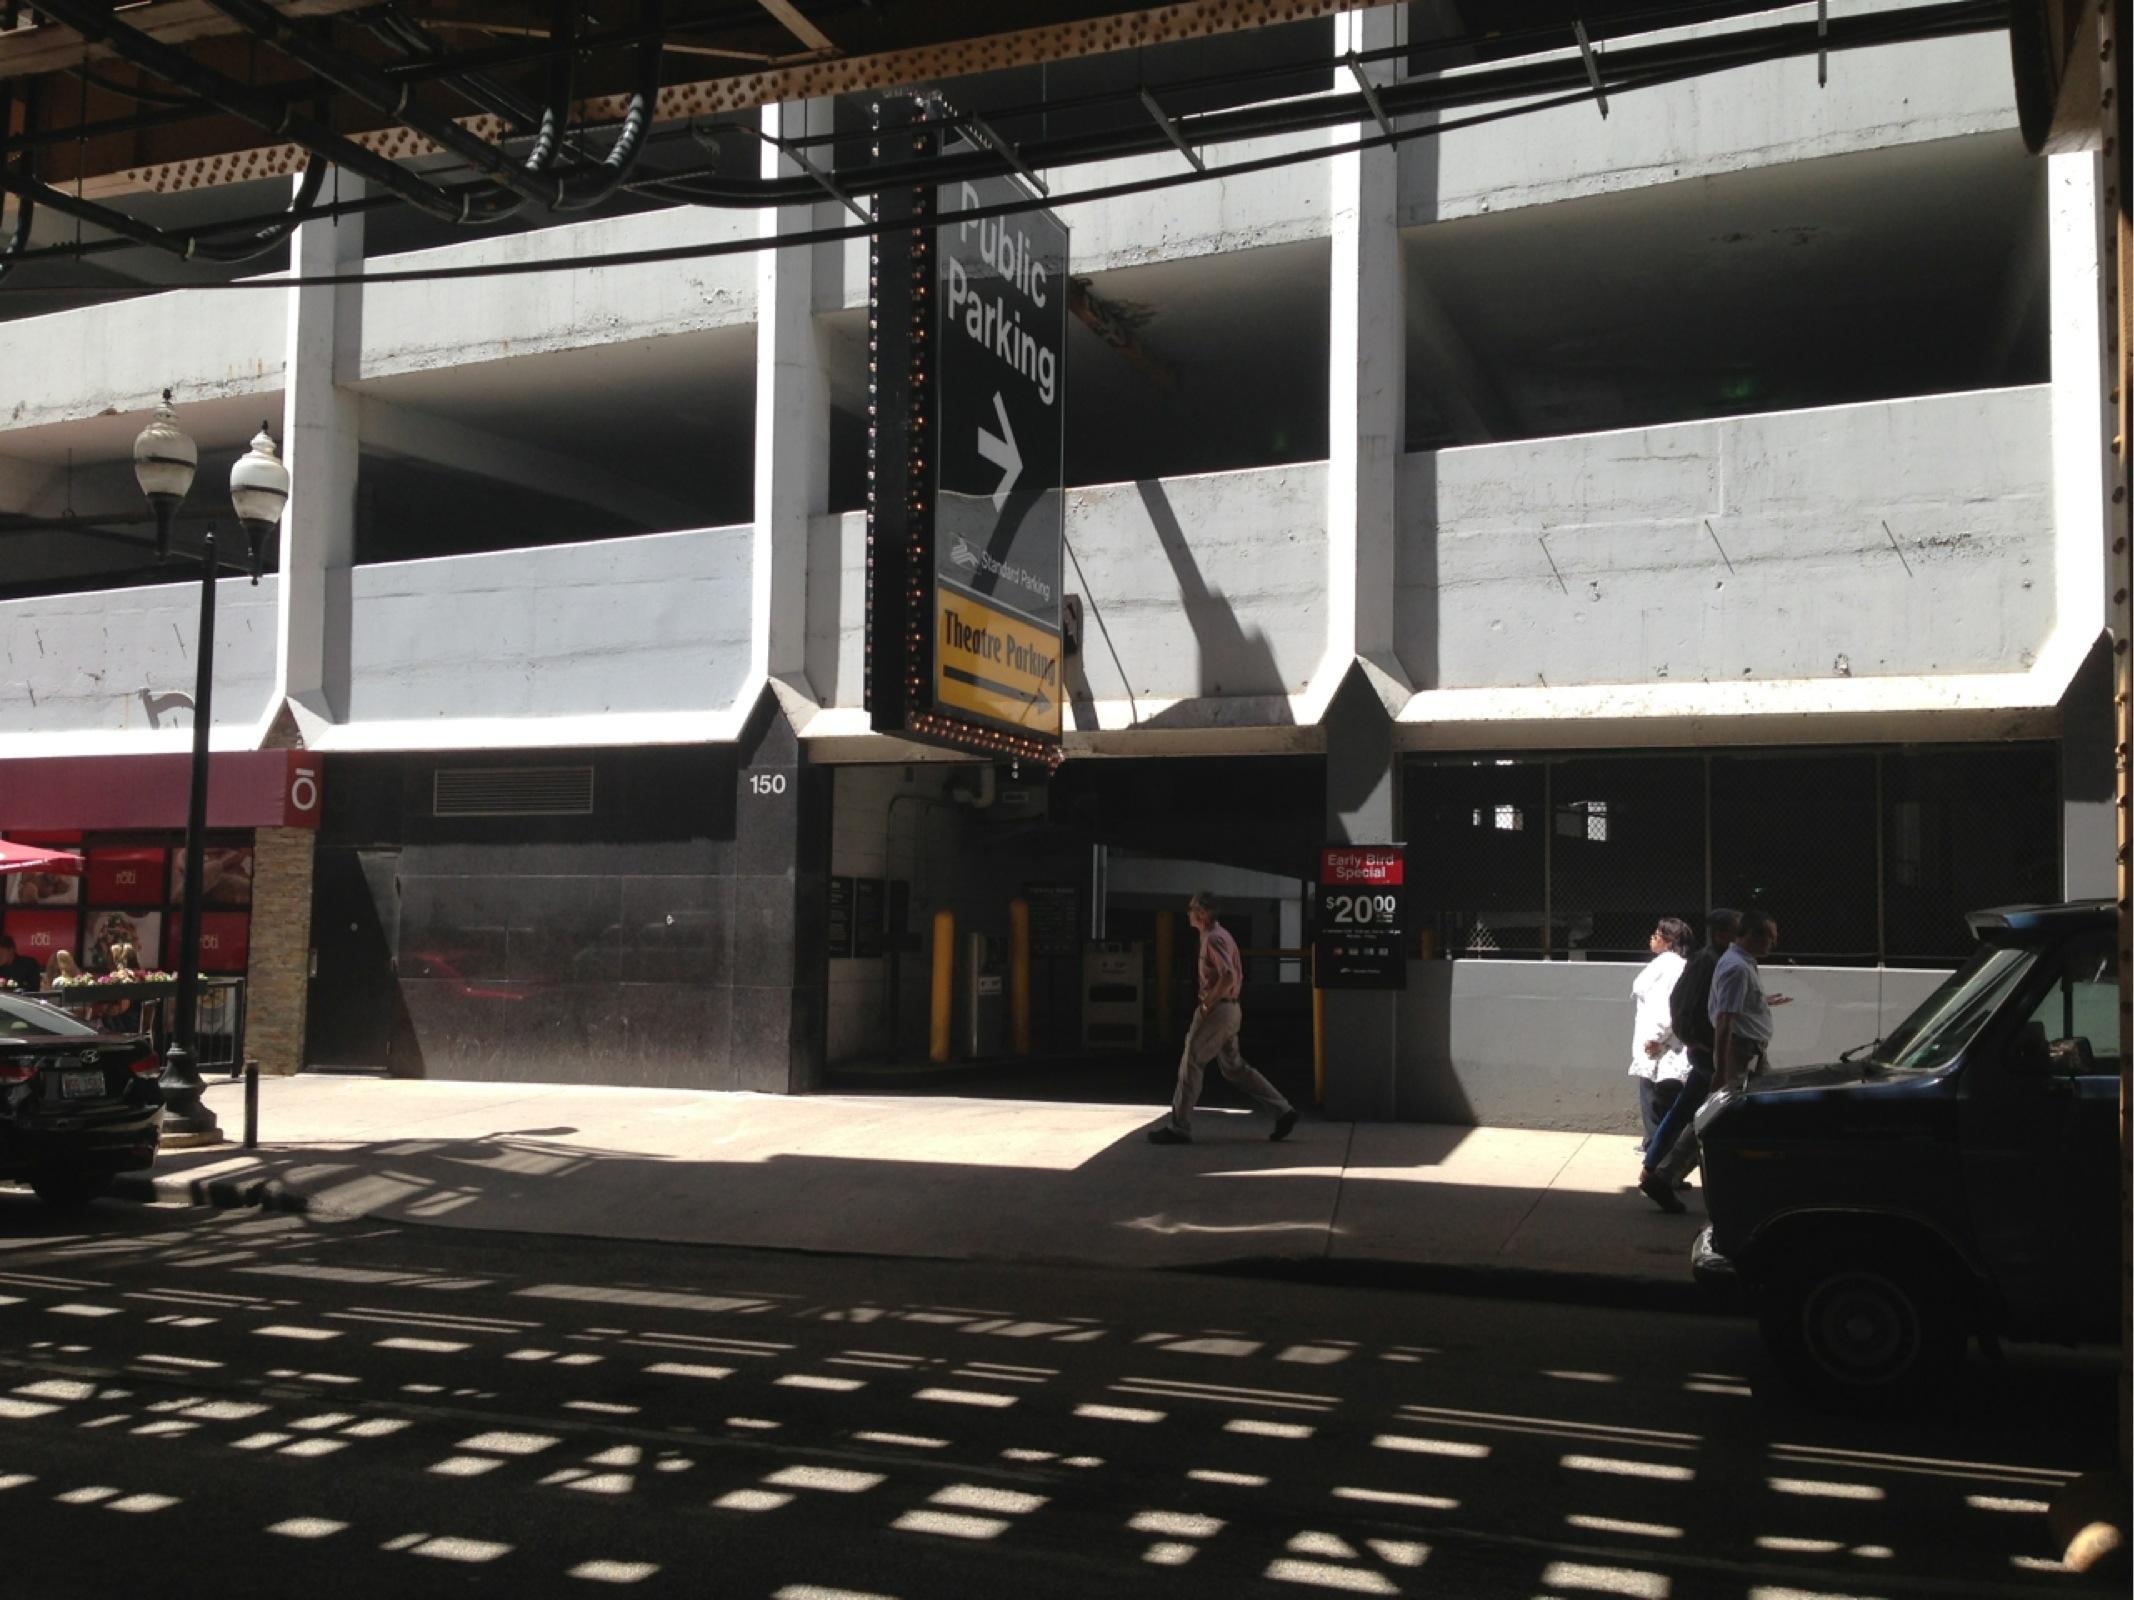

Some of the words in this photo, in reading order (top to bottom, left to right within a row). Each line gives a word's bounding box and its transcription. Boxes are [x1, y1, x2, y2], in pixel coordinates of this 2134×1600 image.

[960, 181, 1047, 308] Public
[948, 256, 1056, 405] Parking
[981, 550, 1020, 585] Standard
[1021, 568, 1051, 602] Parking
[944, 609, 1002, 663] Theatre
[1006, 633, 1056, 687] Parking
[749, 774, 786, 794] 150
[1327, 854, 1361, 867] Early
[1366, 854, 1395, 866] Bird
[1335, 866, 1386, 880] Special
